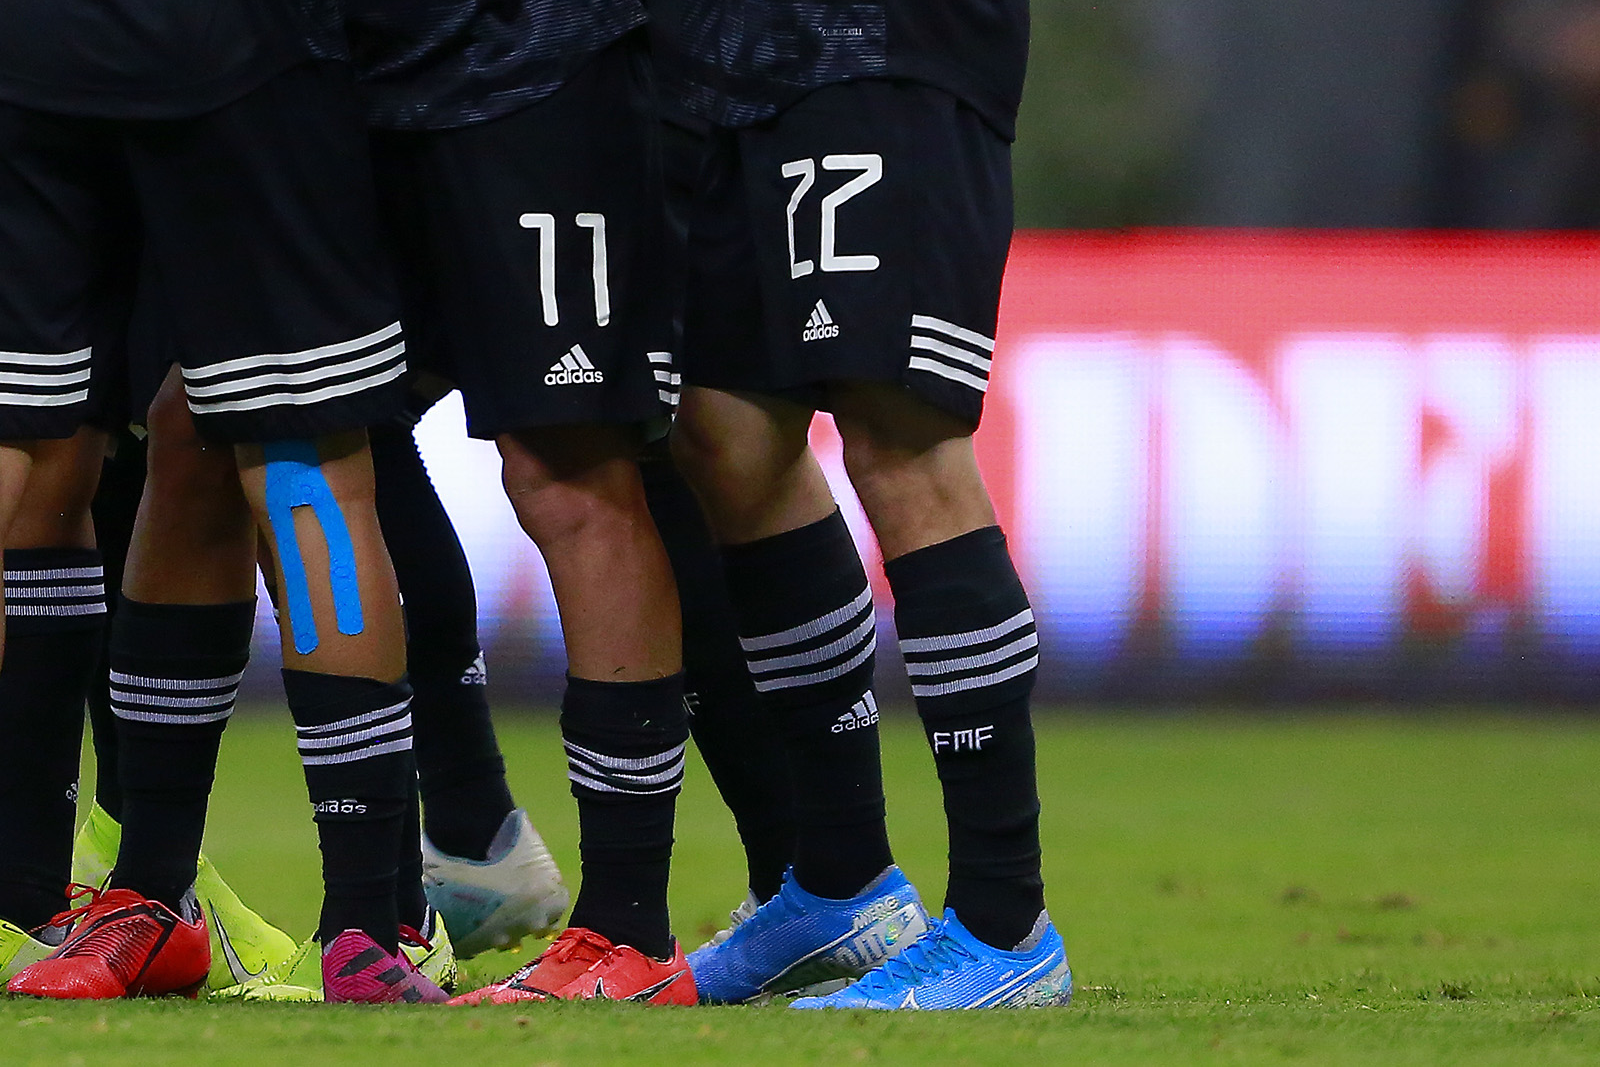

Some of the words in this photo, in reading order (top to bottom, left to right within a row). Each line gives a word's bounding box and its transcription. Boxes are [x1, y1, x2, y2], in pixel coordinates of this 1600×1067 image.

[781, 154, 883, 279] 22
[519, 213, 610, 326] 11
[802, 323, 840, 342] adidas
[544, 368, 604, 385] adidas
[933, 725, 994, 754] FMF
